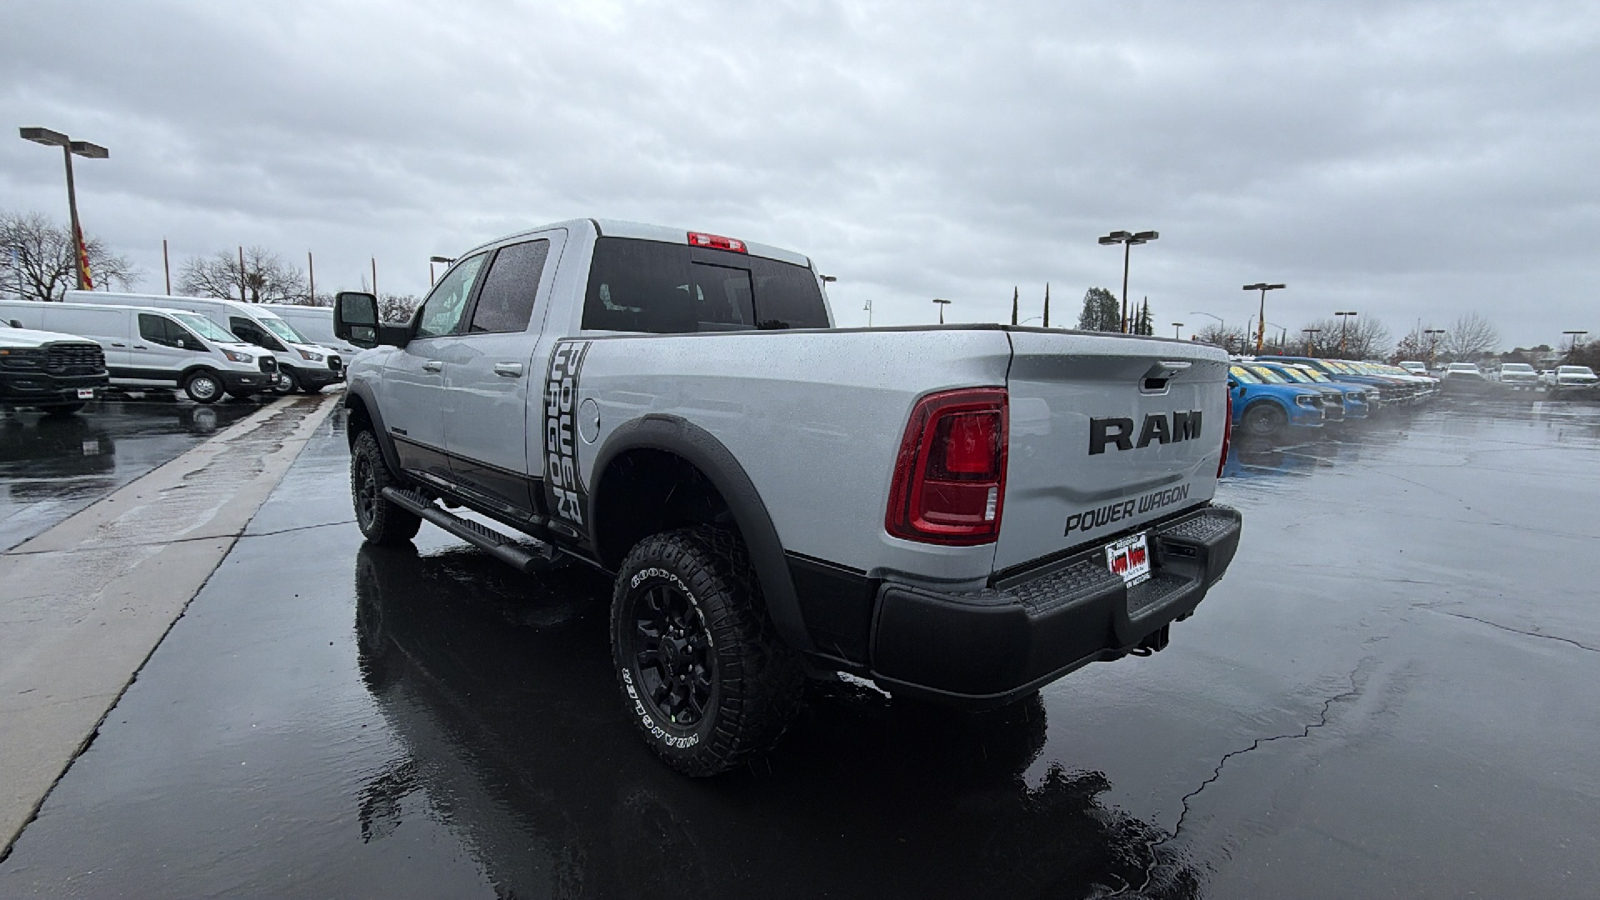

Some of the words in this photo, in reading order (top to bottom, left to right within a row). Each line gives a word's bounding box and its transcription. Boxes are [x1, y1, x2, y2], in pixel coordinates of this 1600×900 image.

[548, 342, 573, 519] WAGON
[559, 342, 585, 525] POWER
[1088, 410, 1202, 455] RAM
[1064, 500, 1135, 536] POWER
[1138, 484, 1190, 514] WAGON
[631, 568, 713, 647] GOODYEAR
[622, 667, 699, 748] WRANGLER
